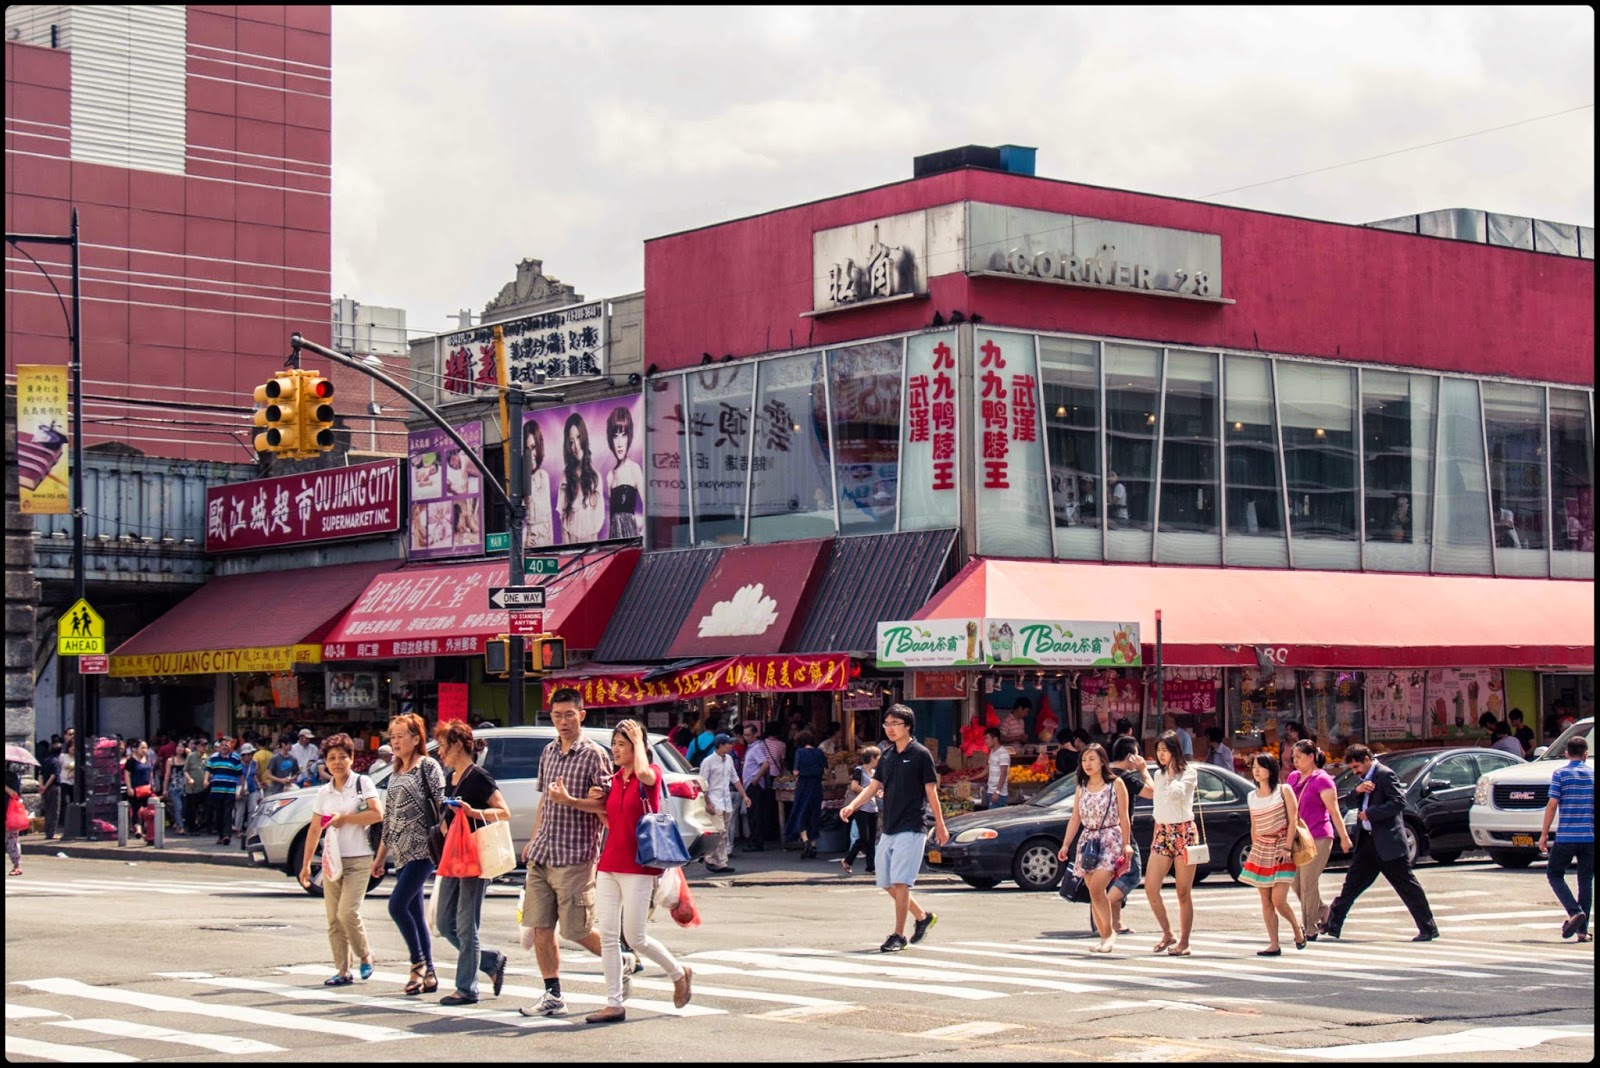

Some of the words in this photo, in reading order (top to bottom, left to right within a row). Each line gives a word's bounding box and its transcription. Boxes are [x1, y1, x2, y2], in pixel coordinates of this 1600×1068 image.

[1006, 247, 1155, 290] CORNER
[1174, 269, 1210, 296] 28
[908, 375, 930, 443] 武漢
[1012, 374, 1036, 442] 武漢
[367, 465, 396, 505] CITY
[322, 512, 374, 532] SUPERMARKET
[374, 508, 391, 524] INC.
[490, 536, 502, 547] MAIN
[529, 560, 544, 573] 40
[352, 572, 481, 615] 紐約同仁堂
[503, 593, 519, 603] ONE
[523, 592, 541, 602] WAY
[64, 637, 99, 652] AHEAD
[324, 643, 346, 658] 40-34
[356, 643, 379, 657] 同仁堂
[212, 649, 242, 671] CITY
[674, 671, 718, 696] 135-24
[1509, 791, 1536, 800] GMC
